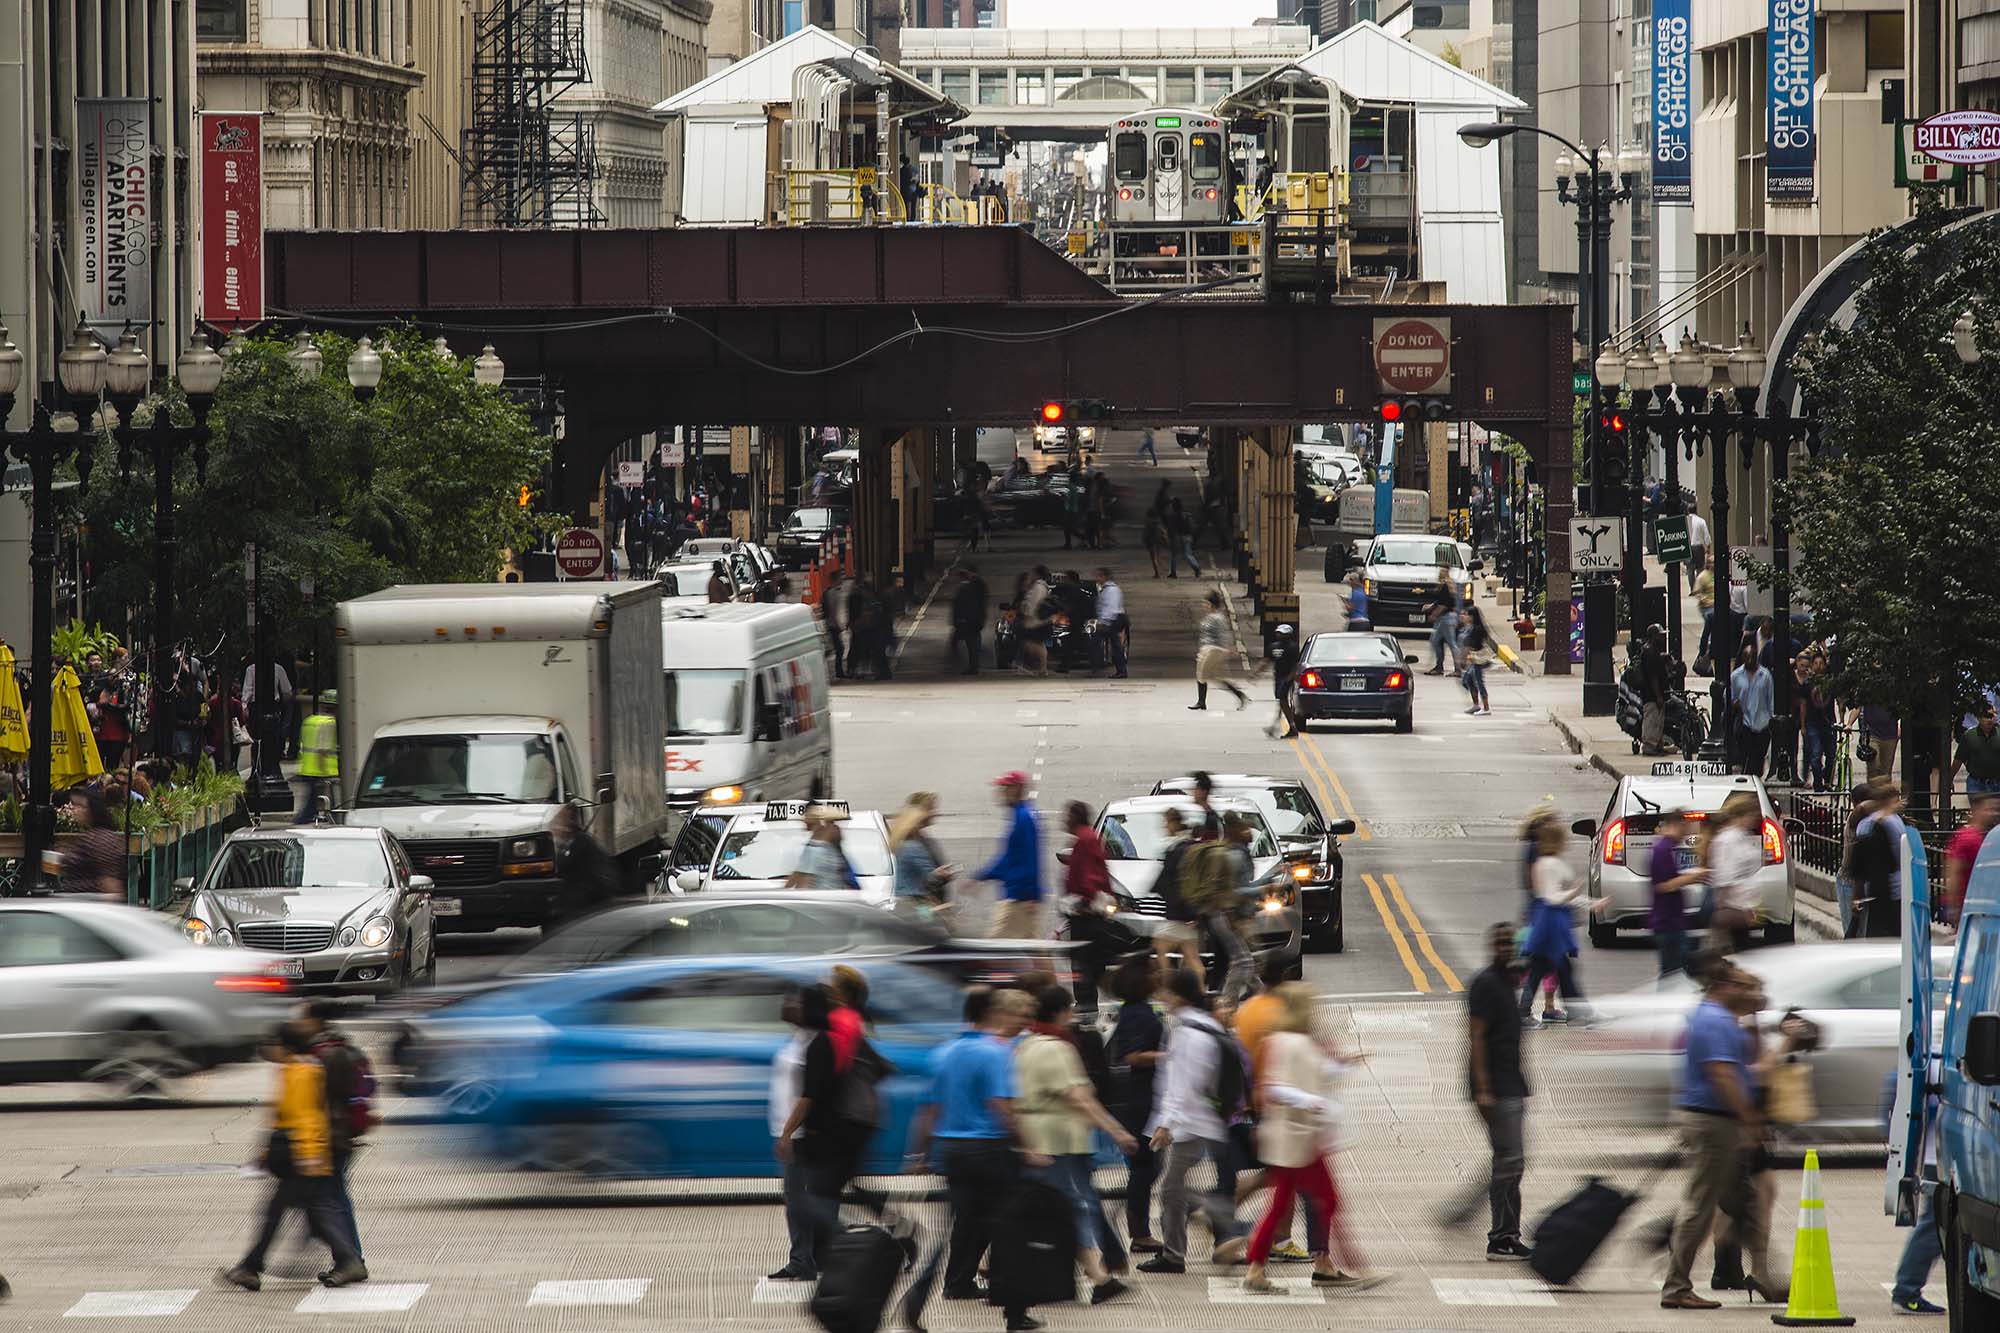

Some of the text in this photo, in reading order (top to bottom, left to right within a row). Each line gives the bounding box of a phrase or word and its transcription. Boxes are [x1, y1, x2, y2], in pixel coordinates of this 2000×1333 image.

[1658, 17, 1670, 161] CITY COLLEGES
[1671, 16, 1686, 161] OF CHICAGO
[1774, 98, 1789, 148] CITY
[1790, 115, 1809, 147] OF
[1917, 126, 1963, 148] BILLY
[1912, 155, 1944, 164] ELEV
[225, 160, 238, 183] eat
[1358, 175, 1368, 212] peps
[82, 142, 98, 283] villagegreen.com
[225, 210, 239, 247] drink
[225, 267, 240, 311] enjoy!
[1389, 335, 1434, 346] DO NOT
[1391, 366, 1433, 377] ENTER
[562, 538, 596, 548] DO NOT
[1658, 529, 1687, 543] PARKING
[566, 559, 593, 568] ENTER
[1580, 556, 1612, 567] ONLY
[1656, 763, 1673, 775] TAXI
[1708, 763, 1726, 775] TAXI
[768, 805, 787, 818] TAXI
